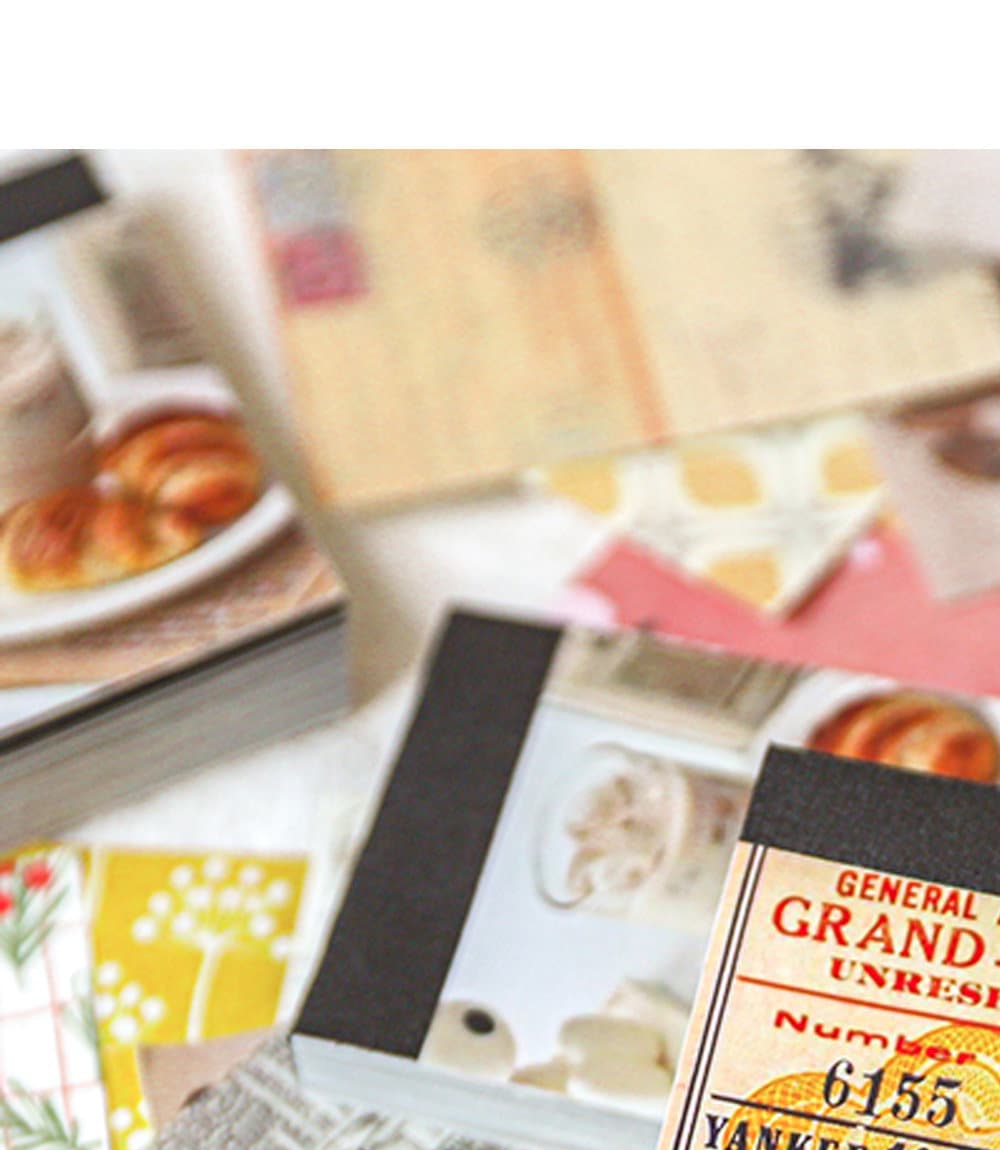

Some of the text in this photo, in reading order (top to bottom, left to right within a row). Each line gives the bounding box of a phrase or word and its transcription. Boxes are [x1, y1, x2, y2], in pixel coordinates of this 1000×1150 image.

[836, 870, 978, 921] GENERAL
[774, 1009, 977, 1065] Number
[823, 1058, 962, 1128] 6155
